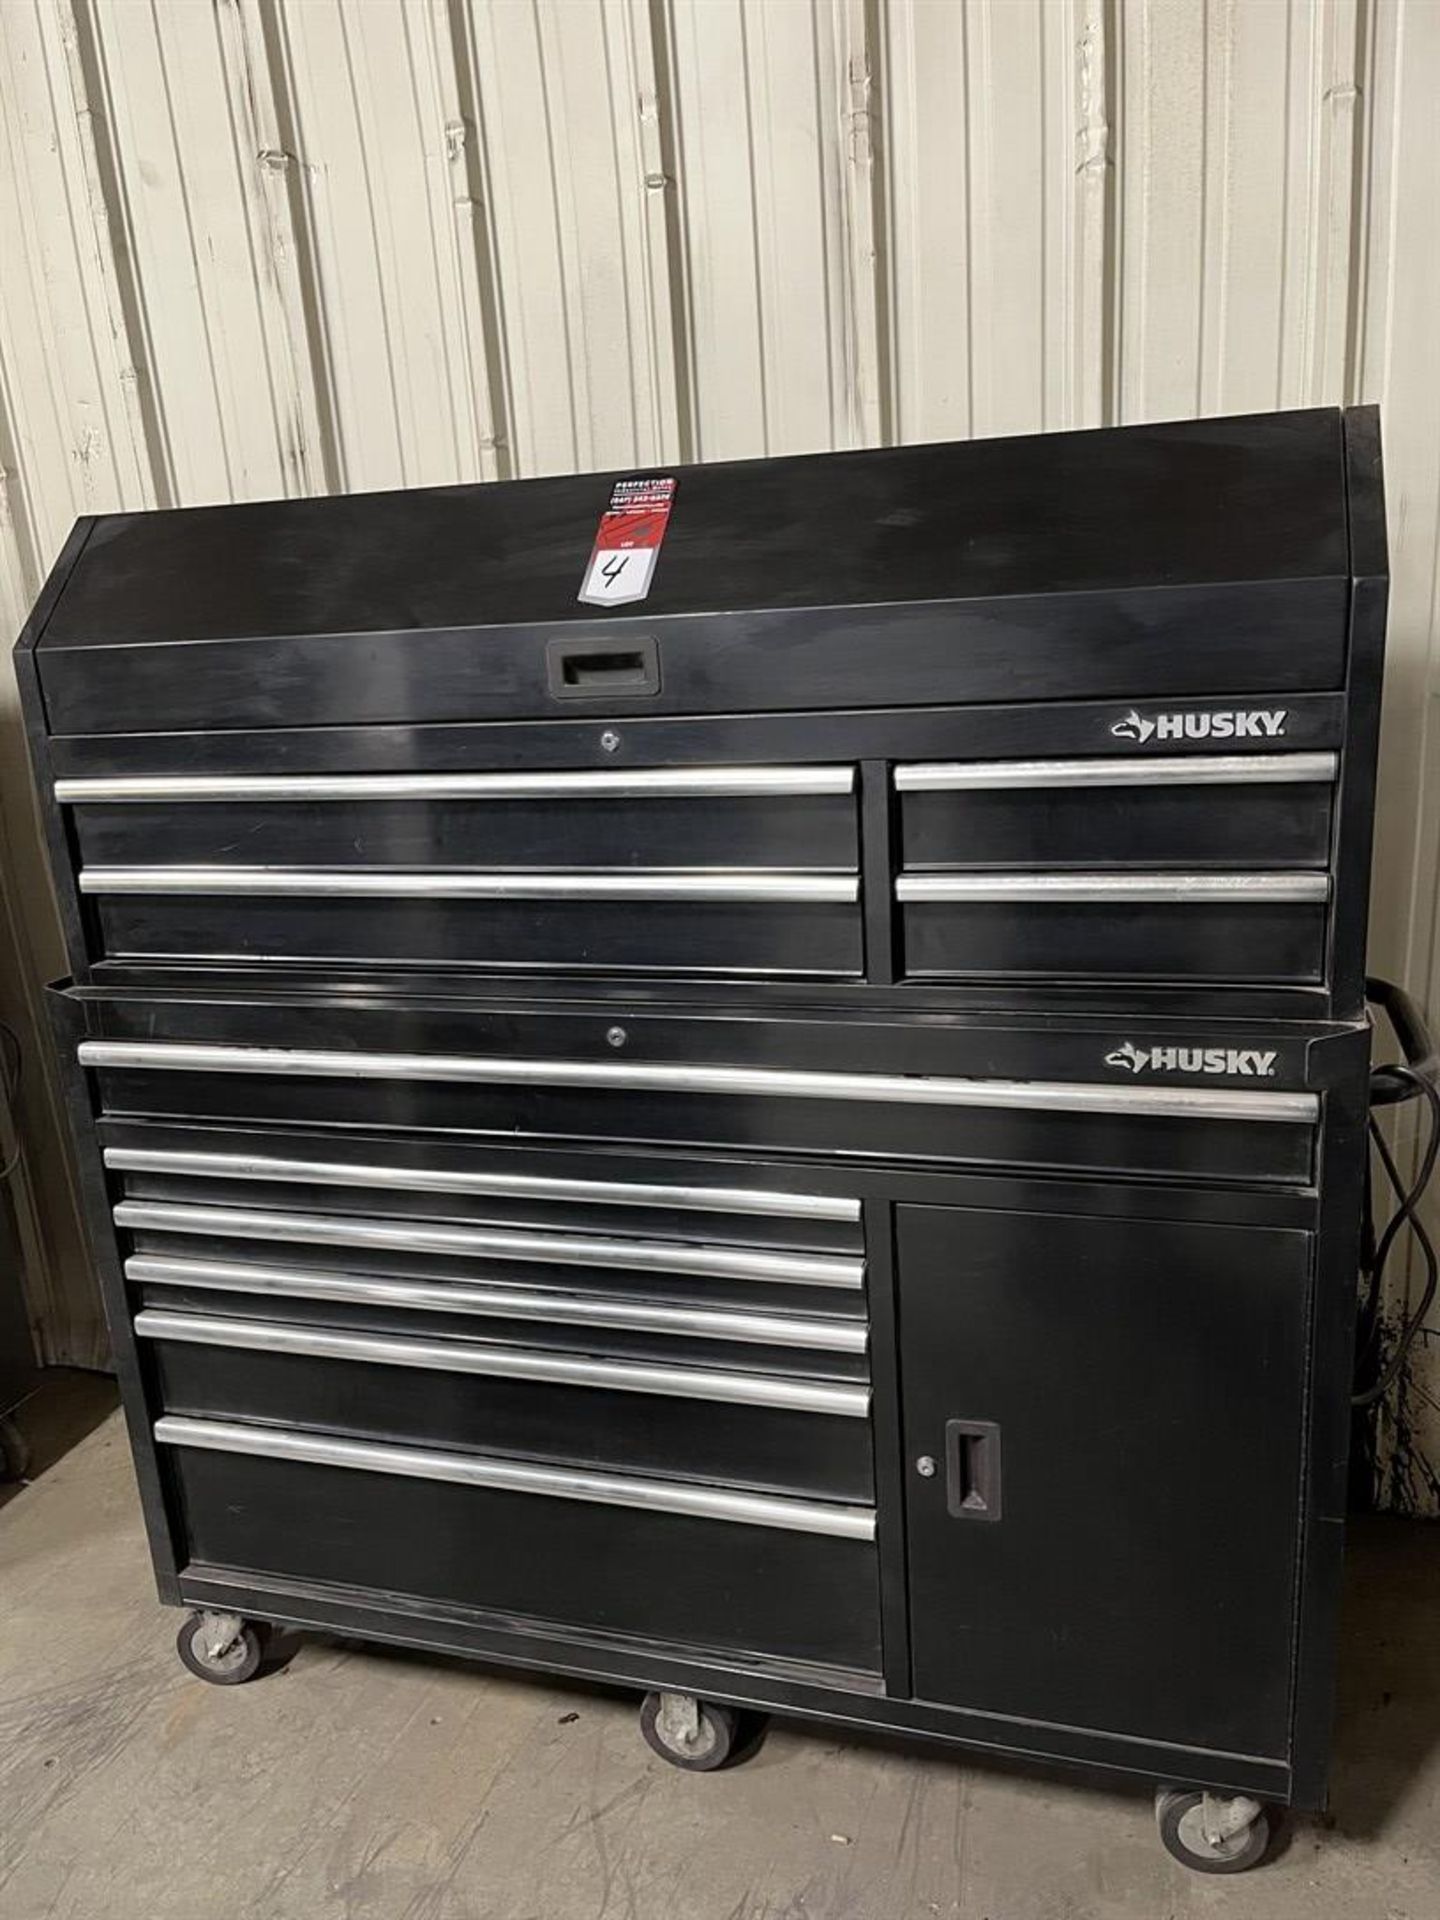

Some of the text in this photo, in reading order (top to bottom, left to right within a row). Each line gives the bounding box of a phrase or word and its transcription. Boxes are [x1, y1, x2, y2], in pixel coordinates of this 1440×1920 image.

[615, 478, 675, 488] PERFECTION
[601, 554, 630, 589] 4
[1157, 711, 1287, 739] HUSKY
[1151, 1047, 1277, 1076] HUSKY
